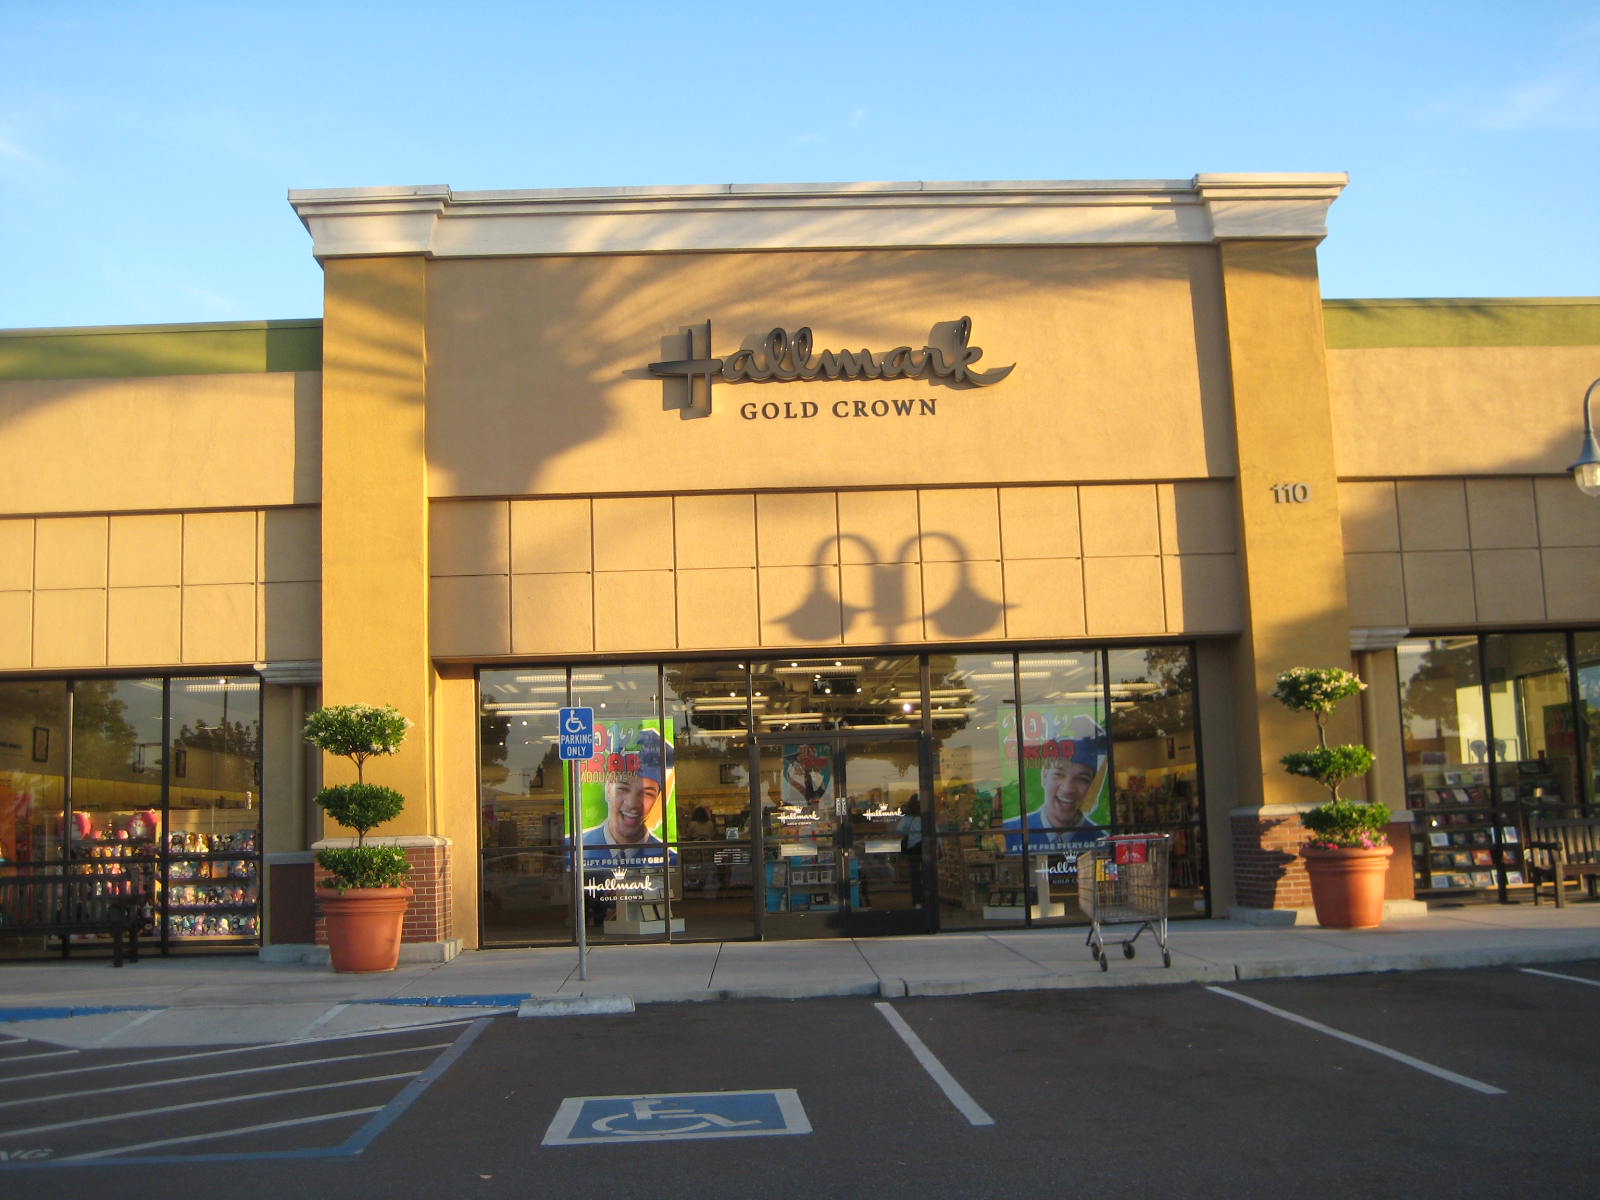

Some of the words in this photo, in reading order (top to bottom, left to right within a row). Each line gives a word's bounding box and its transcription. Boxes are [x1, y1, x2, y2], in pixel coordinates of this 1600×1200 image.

[648, 315, 1016, 416] Hallmark
[740, 401, 819, 420] GOLD
[832, 398, 937, 417] CROWN
[1269, 482, 1312, 504] 110
[561, 734, 592, 745] PARKING
[594, 723, 644, 753] 012
[566, 746, 586, 756] ONLY
[776, 810, 821, 825] Hallmark
[862, 807, 906, 822] Hallmark
[583, 875, 657, 899] Hallmark
[600, 894, 618, 902] GOLD
